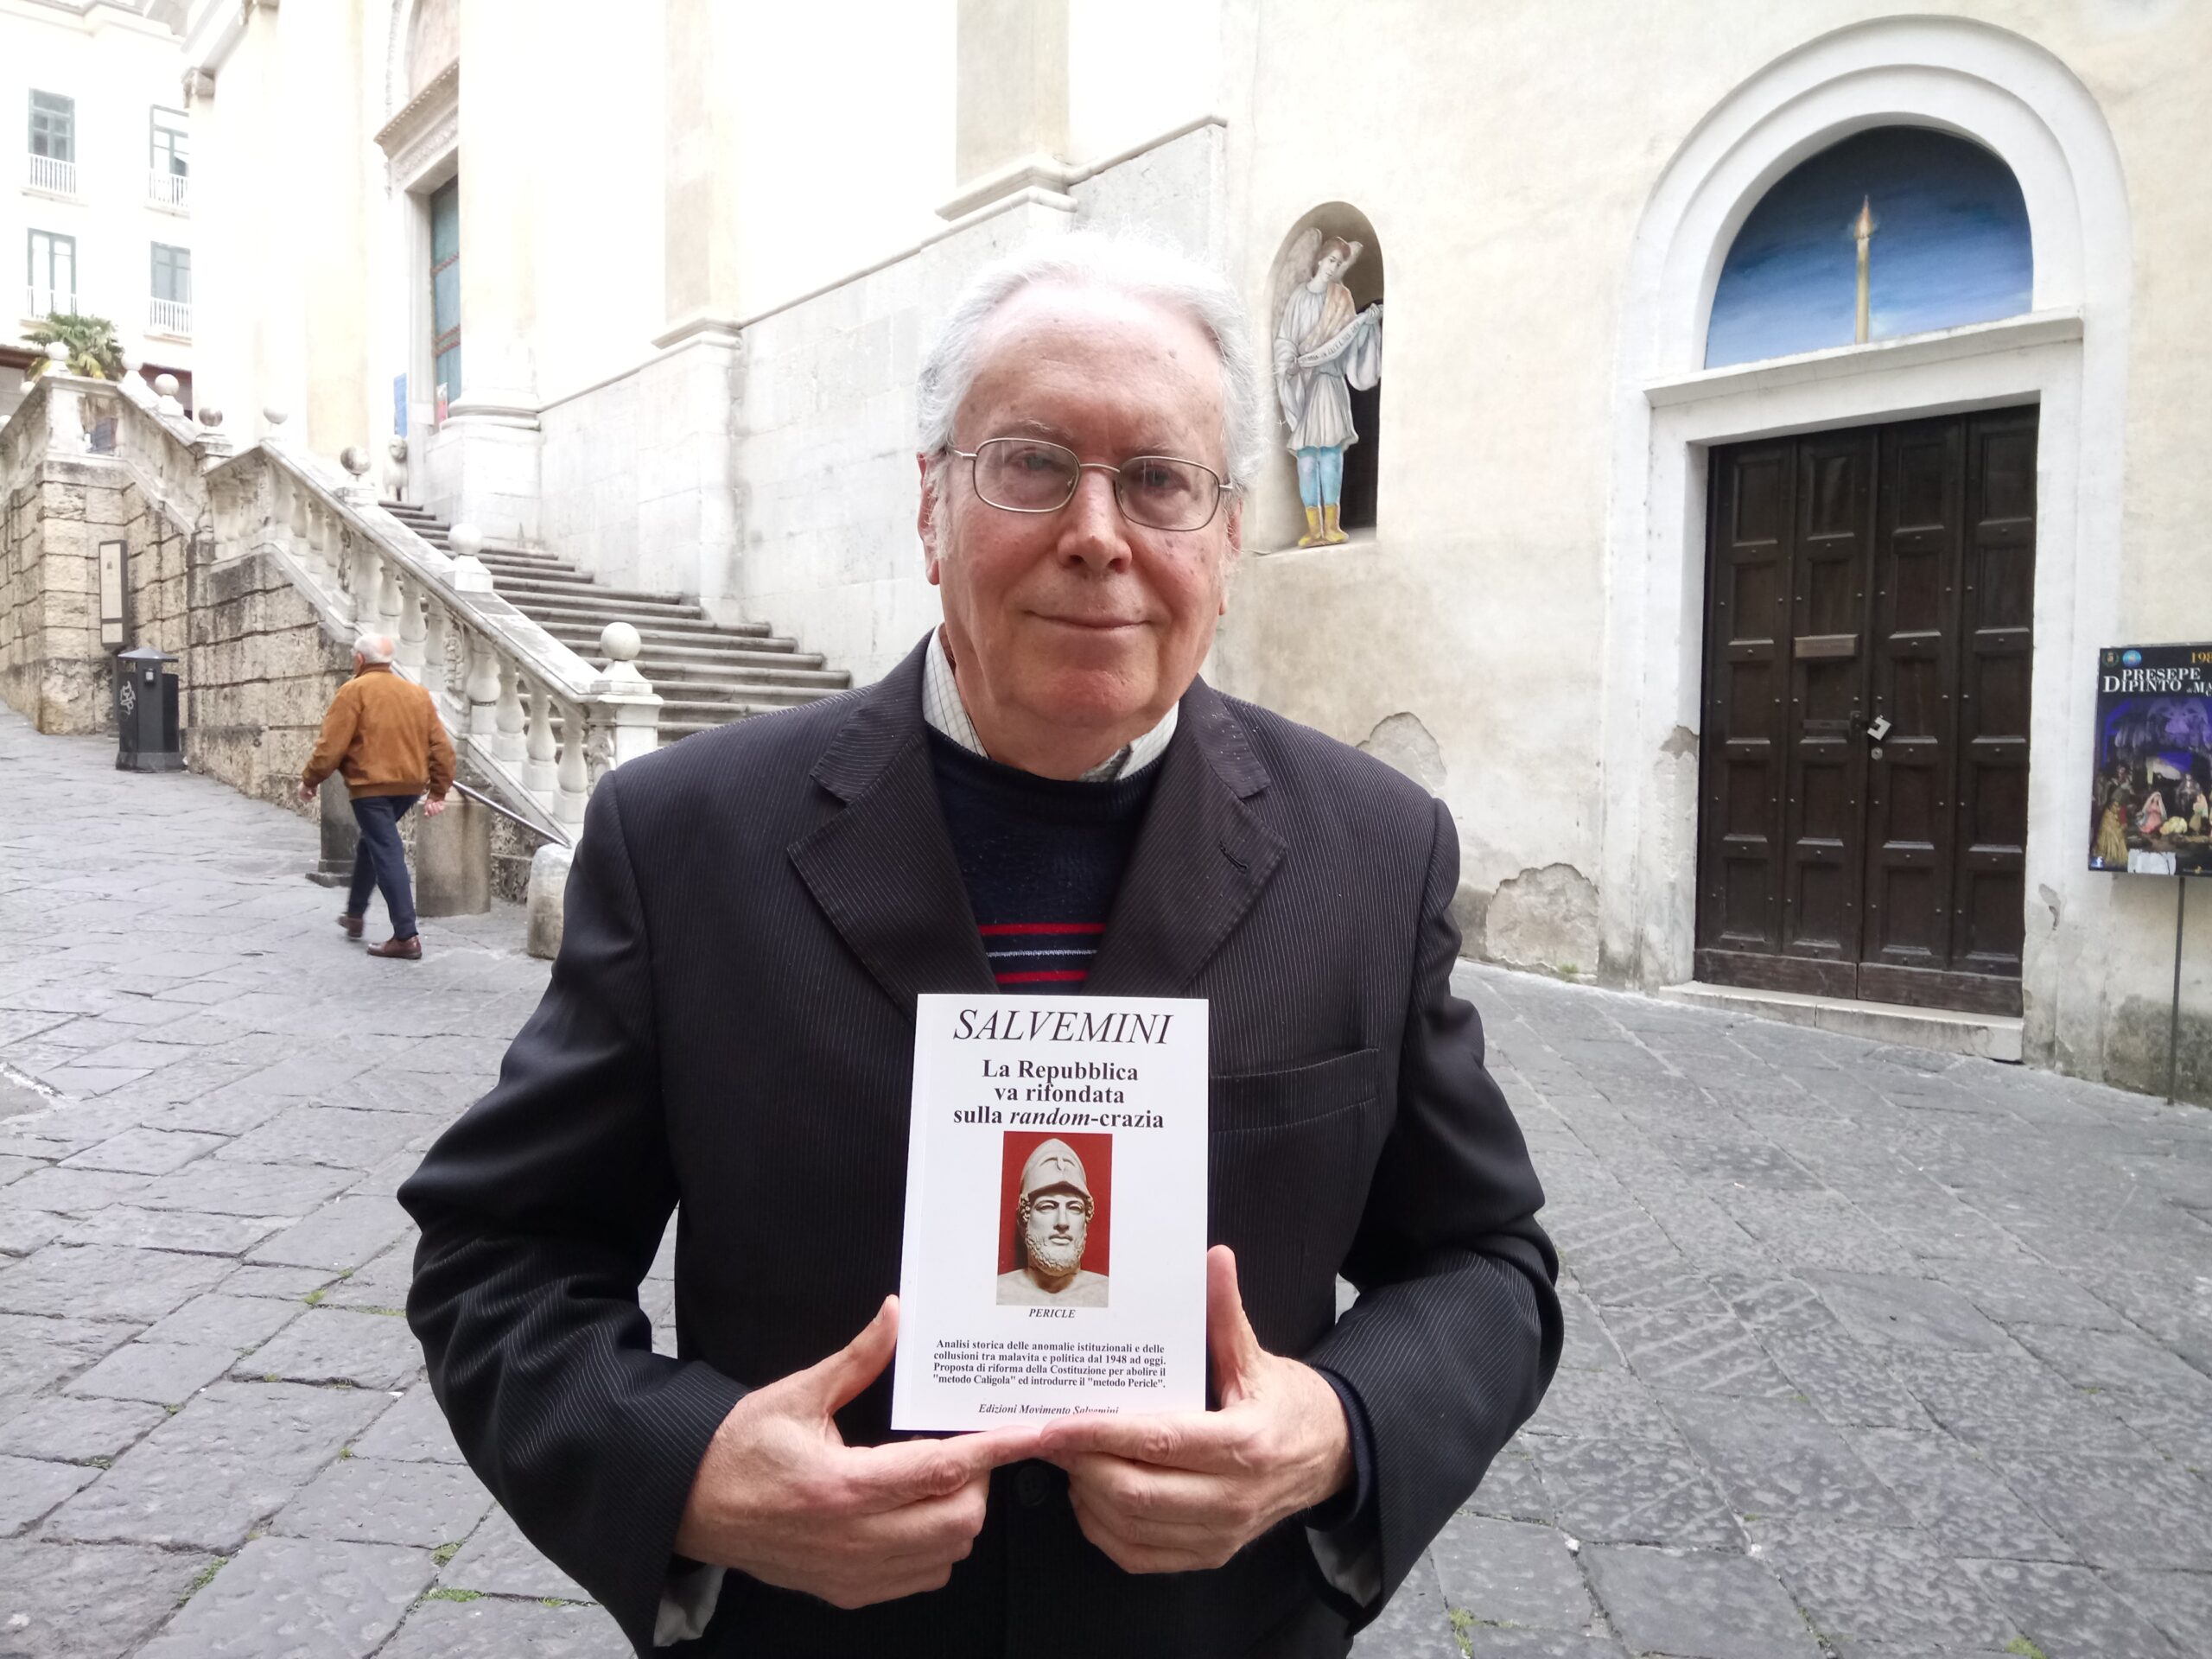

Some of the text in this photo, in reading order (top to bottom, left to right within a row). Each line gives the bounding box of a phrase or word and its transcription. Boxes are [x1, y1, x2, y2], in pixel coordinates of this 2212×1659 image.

[2121, 667, 2201, 681] PRESEPE
[2103, 676, 2183, 692] DIPINTO
[953, 1009, 1173, 1045] SALVEMINI
[982, 1059, 1139, 1084] La Repubblica
[995, 1083, 1125, 1103] va rifondata
[953, 1106, 1164, 1128] sulla random-crazia
[1028, 1308, 1076, 1319] PERICLE
[937, 1339, 969, 1349] Analisi
[972, 1340, 1004, 1350] storica
[1007, 1341, 1029, 1350] delle
[1032, 1342, 1075, 1351] anomalie
[1077, 1342, 1132, 1353] istituzionali
[1142, 1344, 1165, 1353] delle
[934, 1351, 979, 1360] collusioni
[982, 1352, 995, 1361] tra
[999, 1352, 1039, 1362] malavita
[1050, 1354, 1084, 1364] politica
[1088, 1355, 1103, 1363] dal
[1105, 1355, 1127, 1363] 1948
[1129, 1356, 1141, 1364] ad
[1144, 1356, 1166, 1366] oggi.
[933, 1363, 974, 1373] Proposta
[976, 1363, 986, 1372] di
[988, 1363, 1023, 1373] riforma
[1026, 1364, 1047, 1374] della
[1050, 1365, 1107, 1375] Costituzione
[1126, 1367, 1158, 1376] abolire
[1160, 1367, 1166, 1376] il
[933, 1374, 971, 1383] "metodo
[974, 1375, 1015, 1386] Caligola"
[1018, 1376, 1028, 1385] ed
[1031, 1376, 1077, 1386] introdurre
[1079, 1376, 1085, 1386] il
[1088, 1377, 1126, 1387] "metodo
[978, 1403, 1017, 1414] Edizioni
[1019, 1404, 1071, 1414] Movimento
